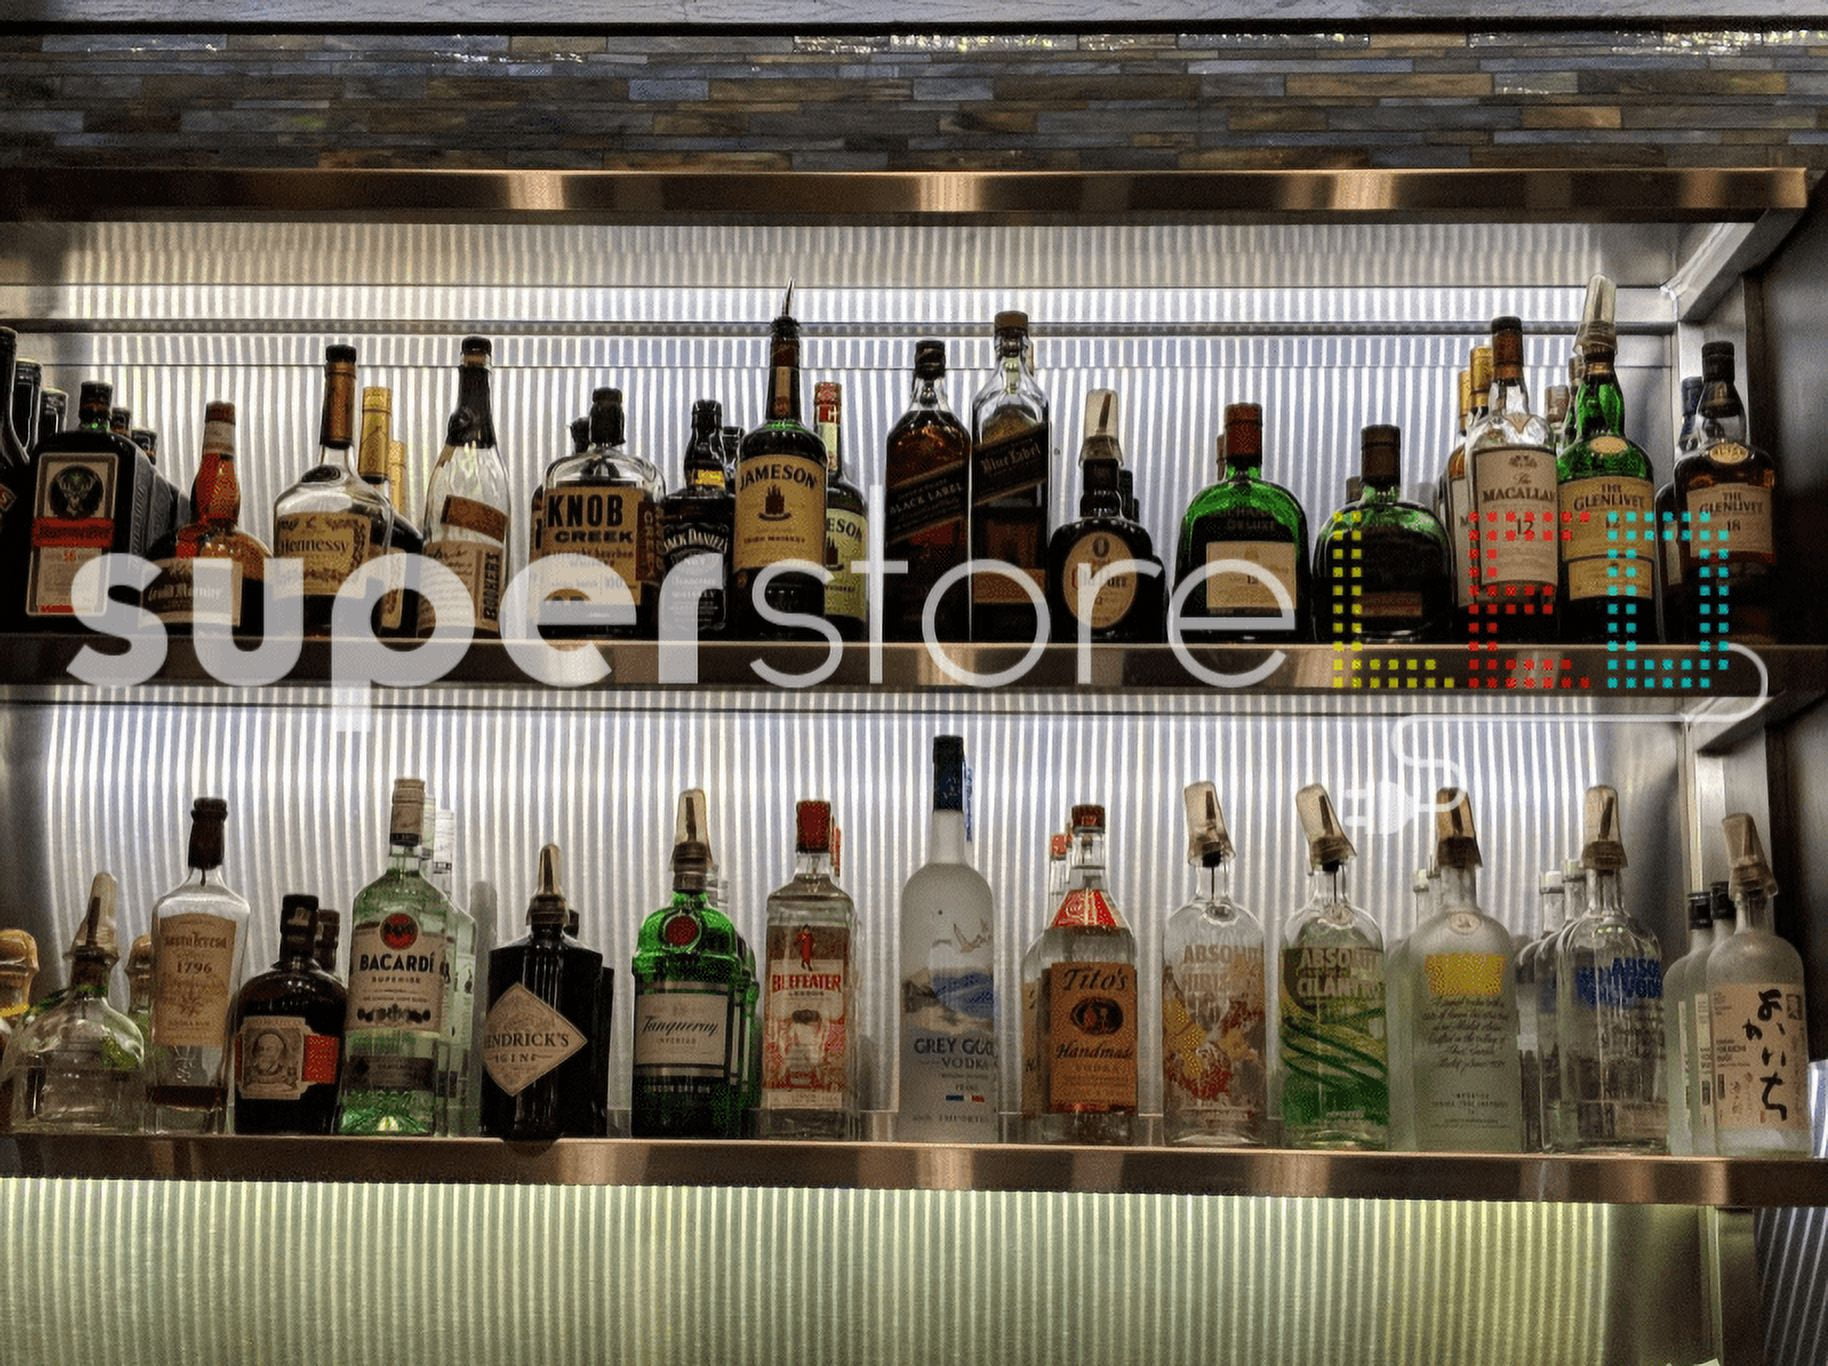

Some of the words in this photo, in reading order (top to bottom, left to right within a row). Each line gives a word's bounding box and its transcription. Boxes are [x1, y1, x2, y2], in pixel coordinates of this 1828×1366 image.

[740, 464, 817, 491] JAMESON
[547, 494, 623, 528] KNOB
[1574, 494, 1645, 511] GLENLIVET
[825, 517, 863, 543] ESON
[1516, 518, 1535, 536] 12
[1727, 520, 1741, 532] 18
[554, 530, 634, 543] CREEK
[279, 538, 347, 557] Hennessy
[176, 961, 213, 974] 1796
[359, 951, 435, 973] BACARDÍ
[1062, 966, 1128, 991] Tito's
[641, 1015, 720, 1037] Tanqueray
[484, 1032, 570, 1048] ENDRICK'S
[914, 1037, 957, 1055] GREY
